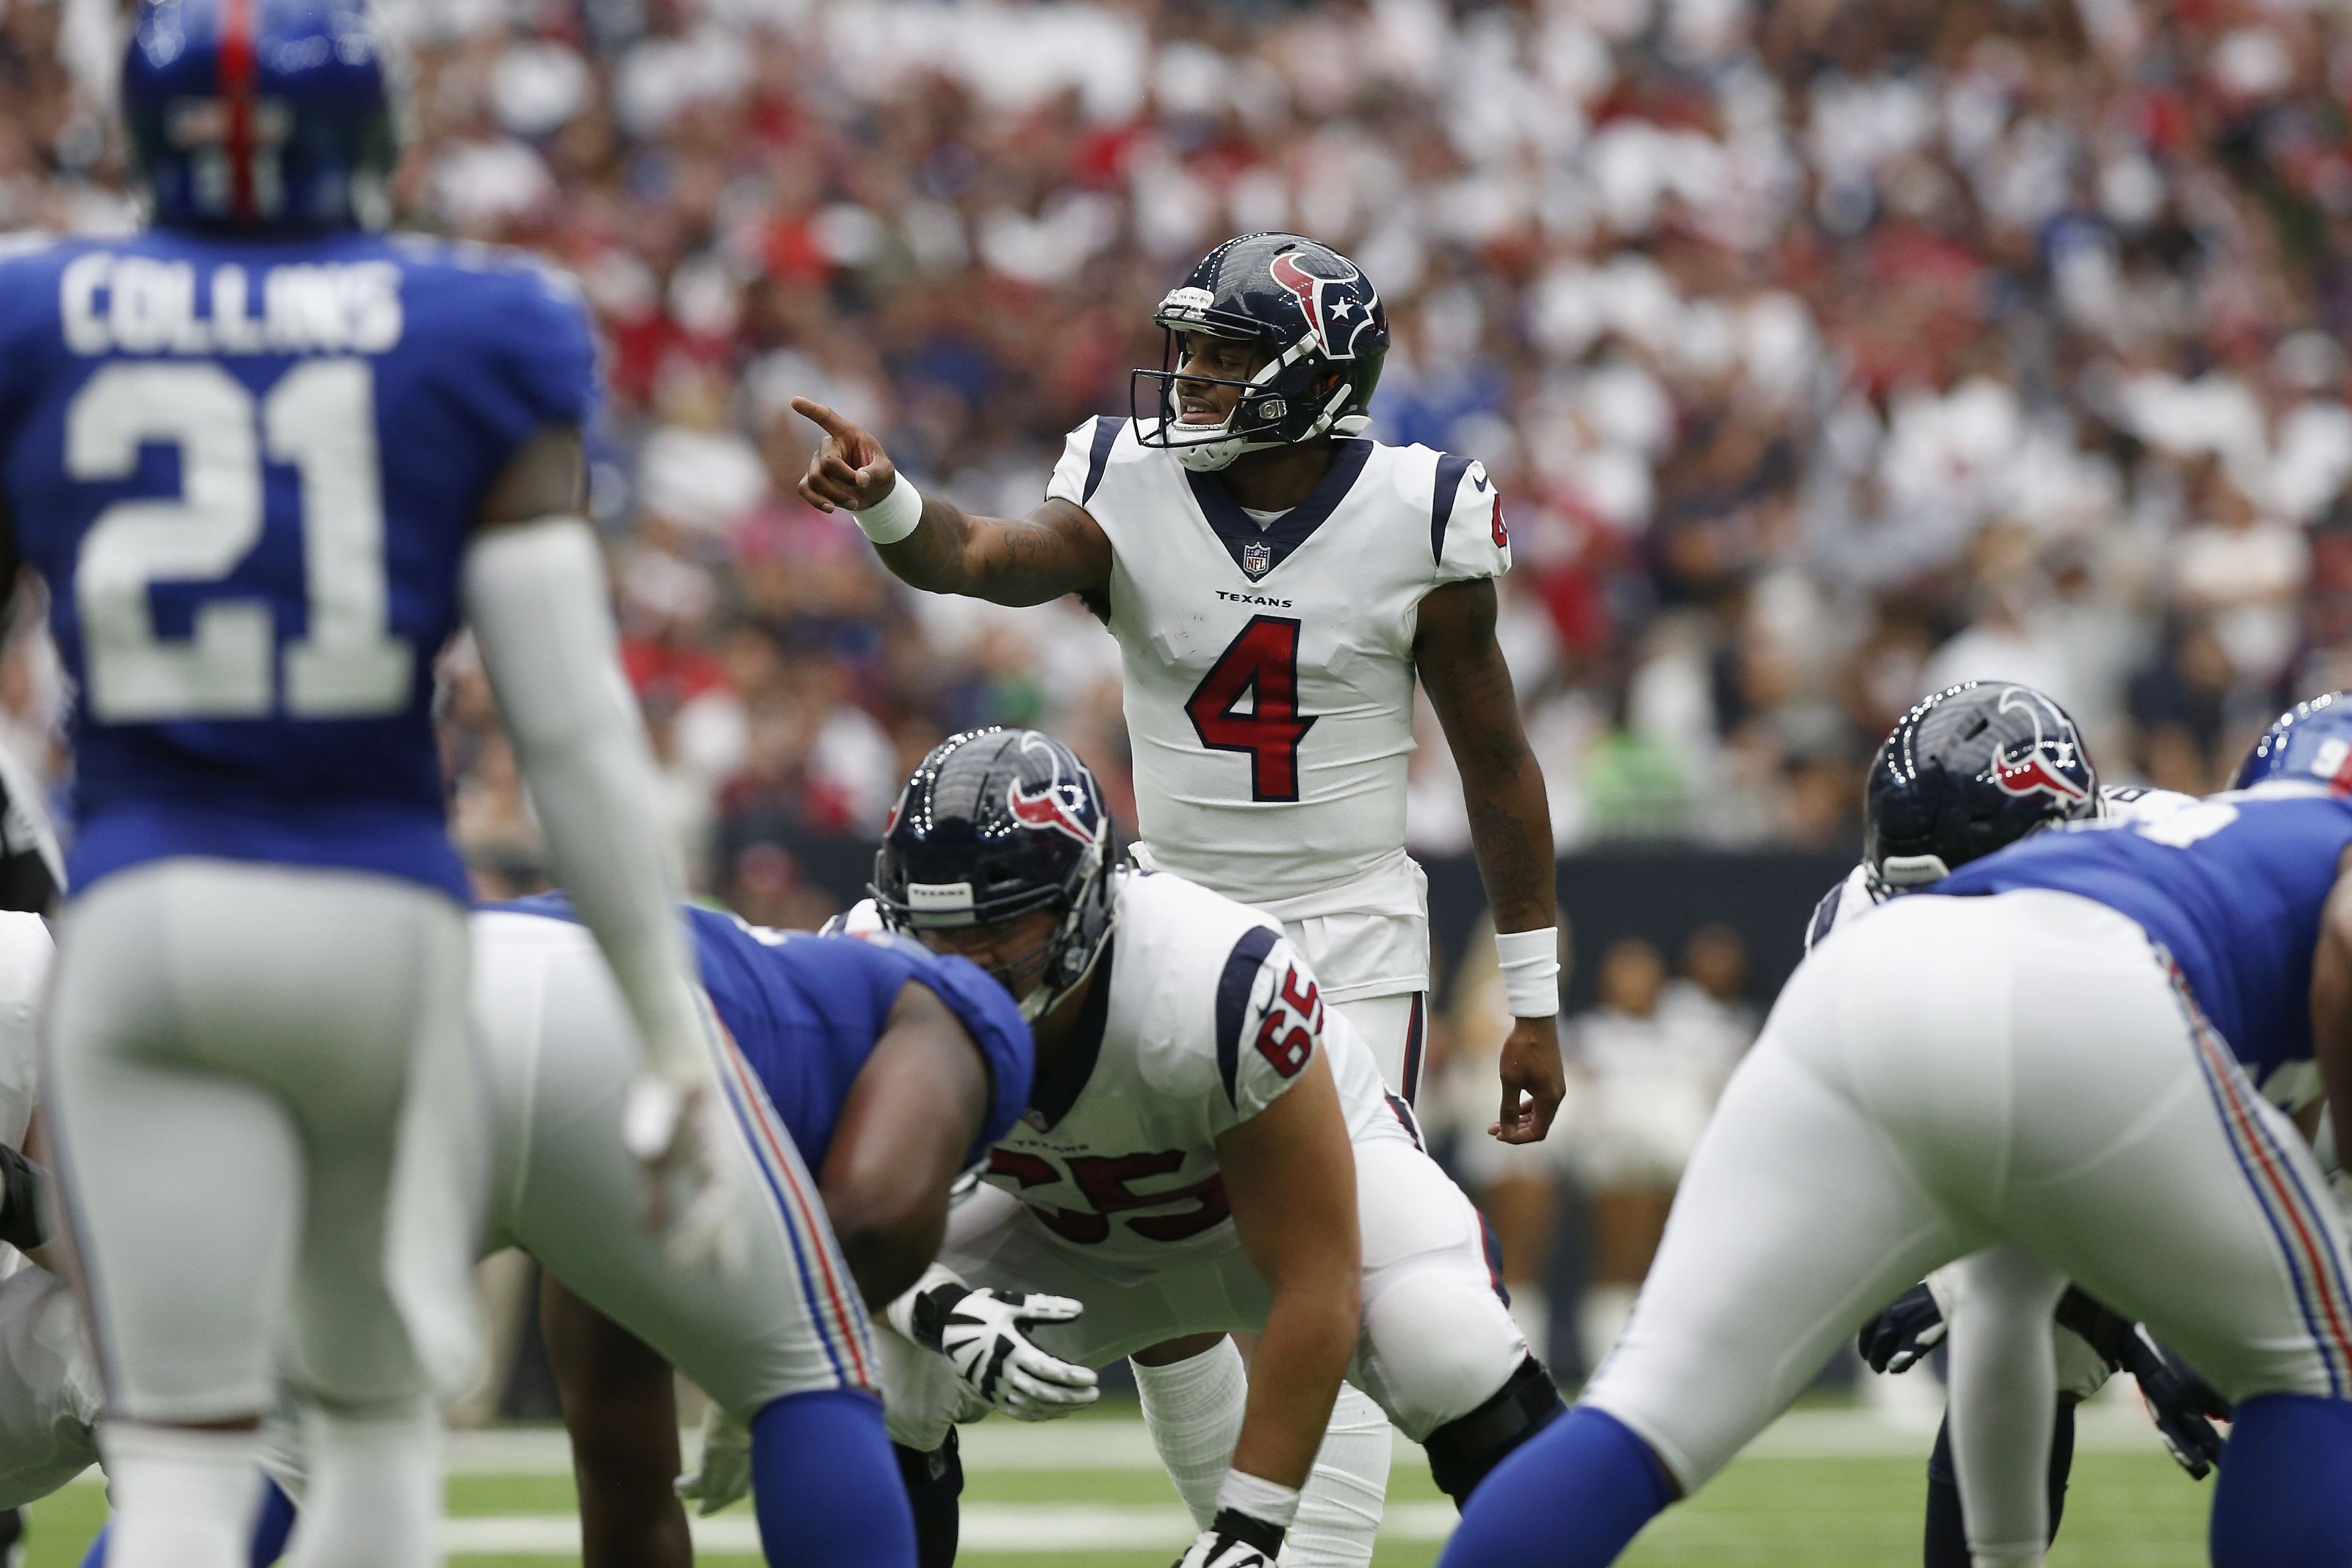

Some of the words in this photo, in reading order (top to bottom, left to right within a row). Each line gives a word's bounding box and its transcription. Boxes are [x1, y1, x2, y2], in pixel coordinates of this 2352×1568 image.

[61, 252, 404, 355] COLLINS
[66, 359, 413, 722] 21
[1247, 556, 1266, 570] NFL
[1216, 590, 1293, 608] TEXANS
[1183, 614, 1319, 802] 4
[1255, 959, 1324, 1079] 65
